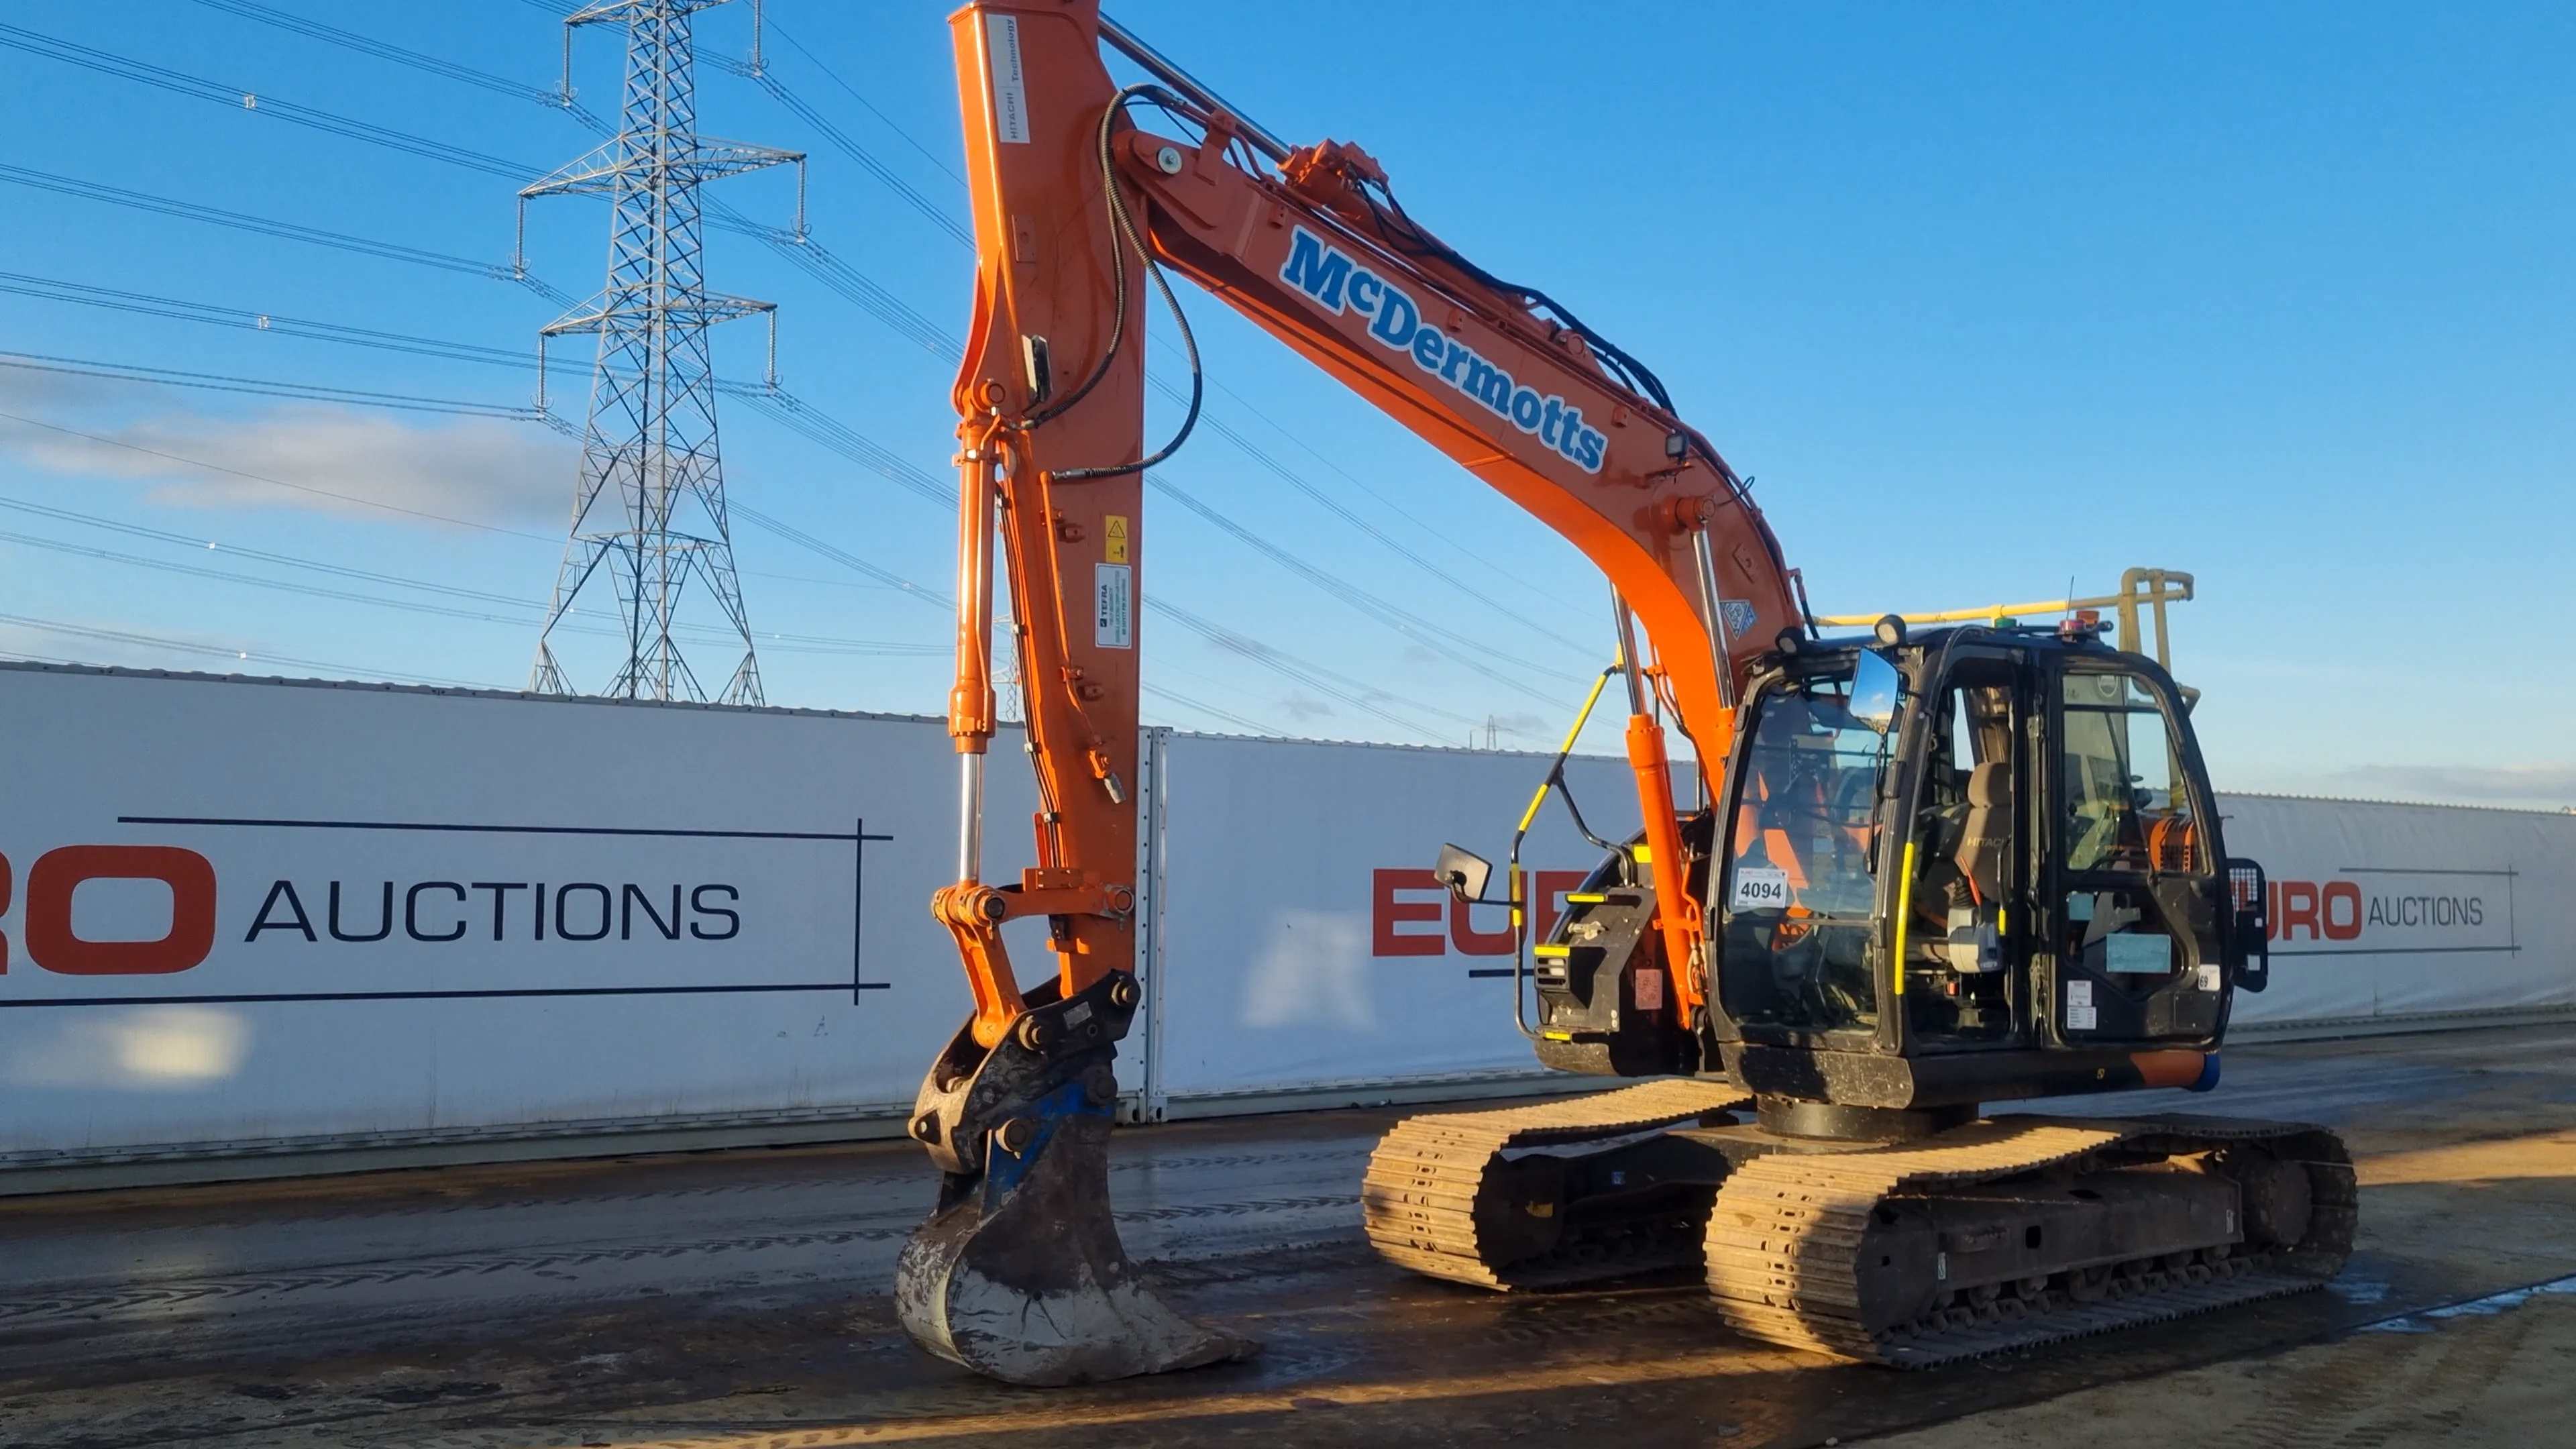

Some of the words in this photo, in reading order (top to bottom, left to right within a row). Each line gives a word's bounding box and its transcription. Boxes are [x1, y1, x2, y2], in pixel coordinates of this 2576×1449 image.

[1006, 18, 1019, 83] Technology
[1006, 92, 1018, 140] HITACHI
[1281, 226, 1607, 472] McDermotts
[0, 845, 217, 975] O
[244, 879, 742, 942] AUCTIONS
[1741, 881, 1782, 899] 4094
[2368, 896, 2483, 926] AUCTIONS
